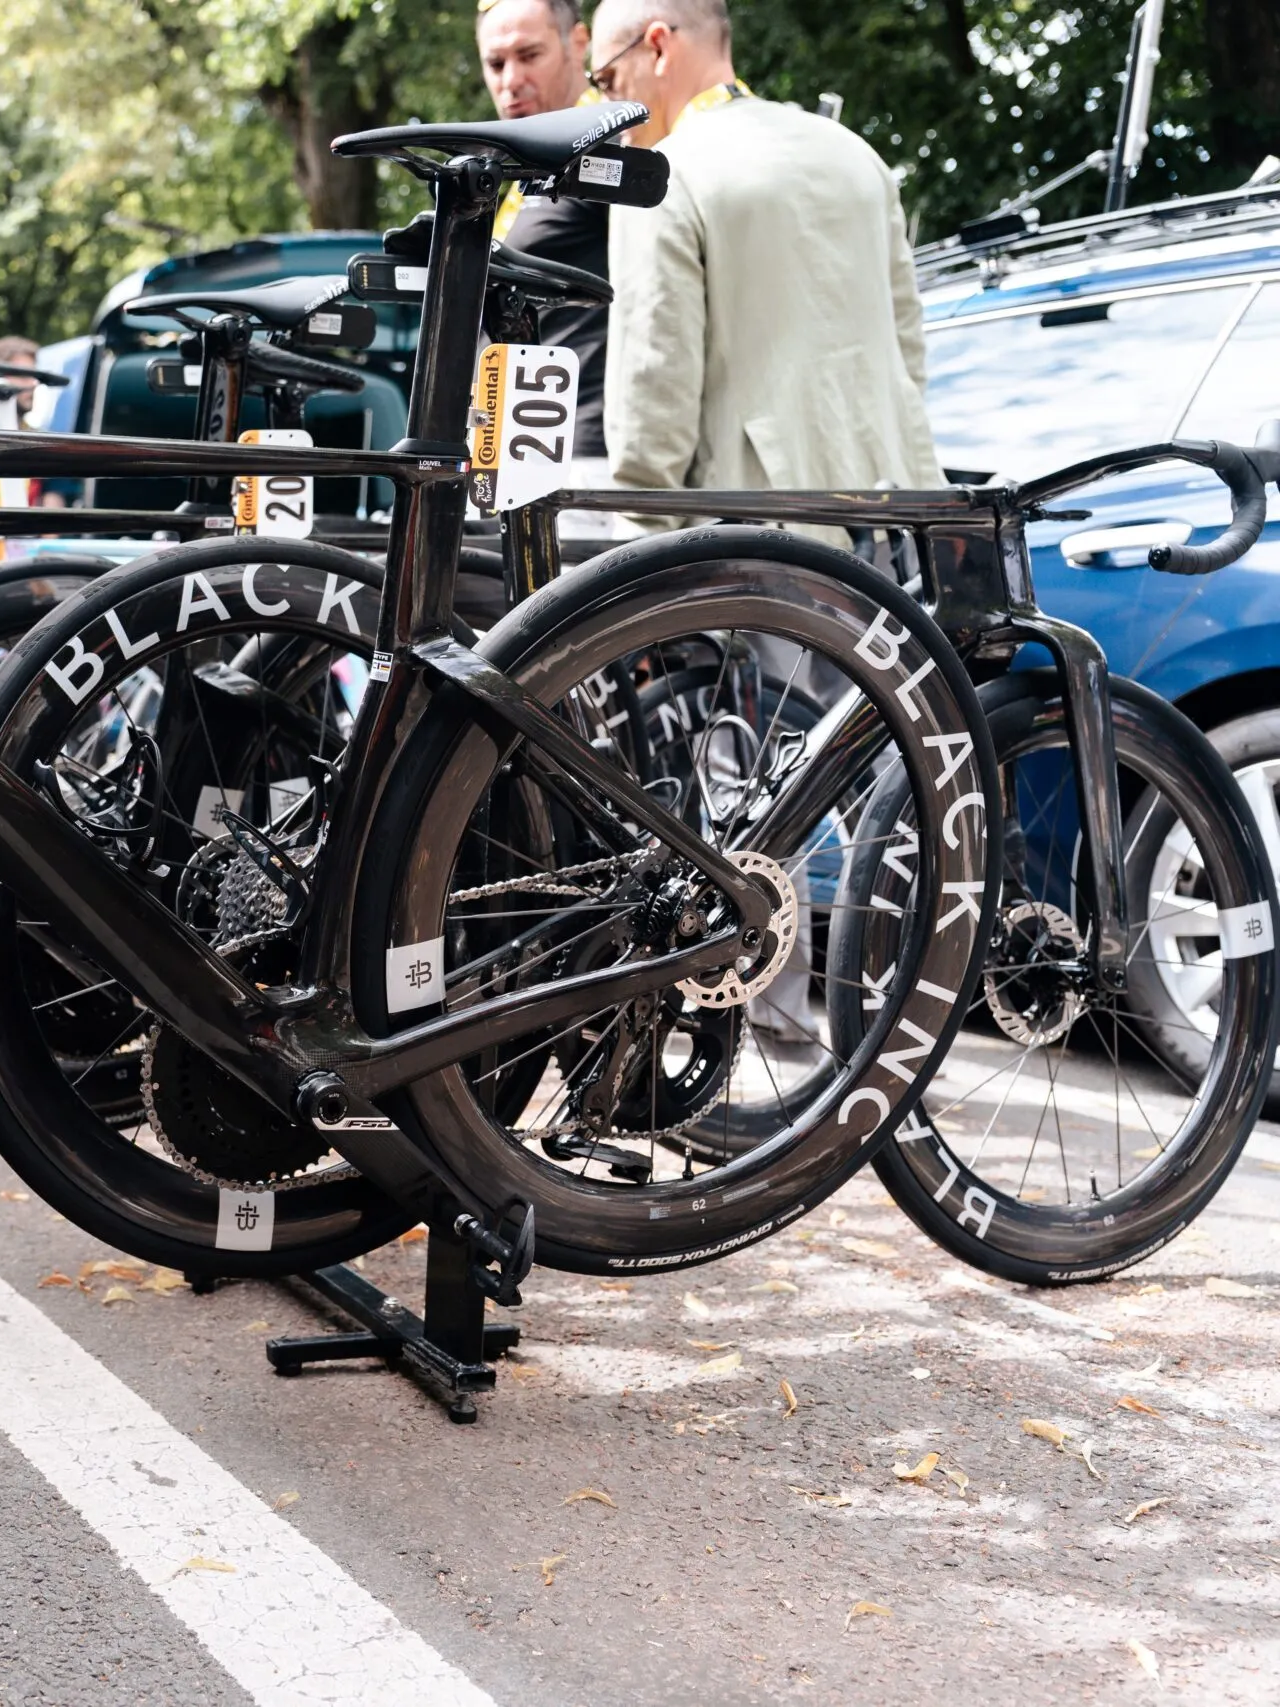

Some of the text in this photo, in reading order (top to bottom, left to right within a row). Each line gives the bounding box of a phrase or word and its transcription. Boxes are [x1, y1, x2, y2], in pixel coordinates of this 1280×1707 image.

[478, 366, 499, 466] Continental
[509, 364, 571, 464] 205
[265, 476, 306, 522] 20
[45, 563, 365, 706] BLACK
[838, 607, 988, 1147] BLACK INC
[862, 820, 997, 1240] BLAK IN
[692, 1199, 706, 1211] 62
[721, 1221, 773, 1251] GRAND
[636, 1255, 683, 1268] 5000
[681, 1245, 721, 1263] PRIX
